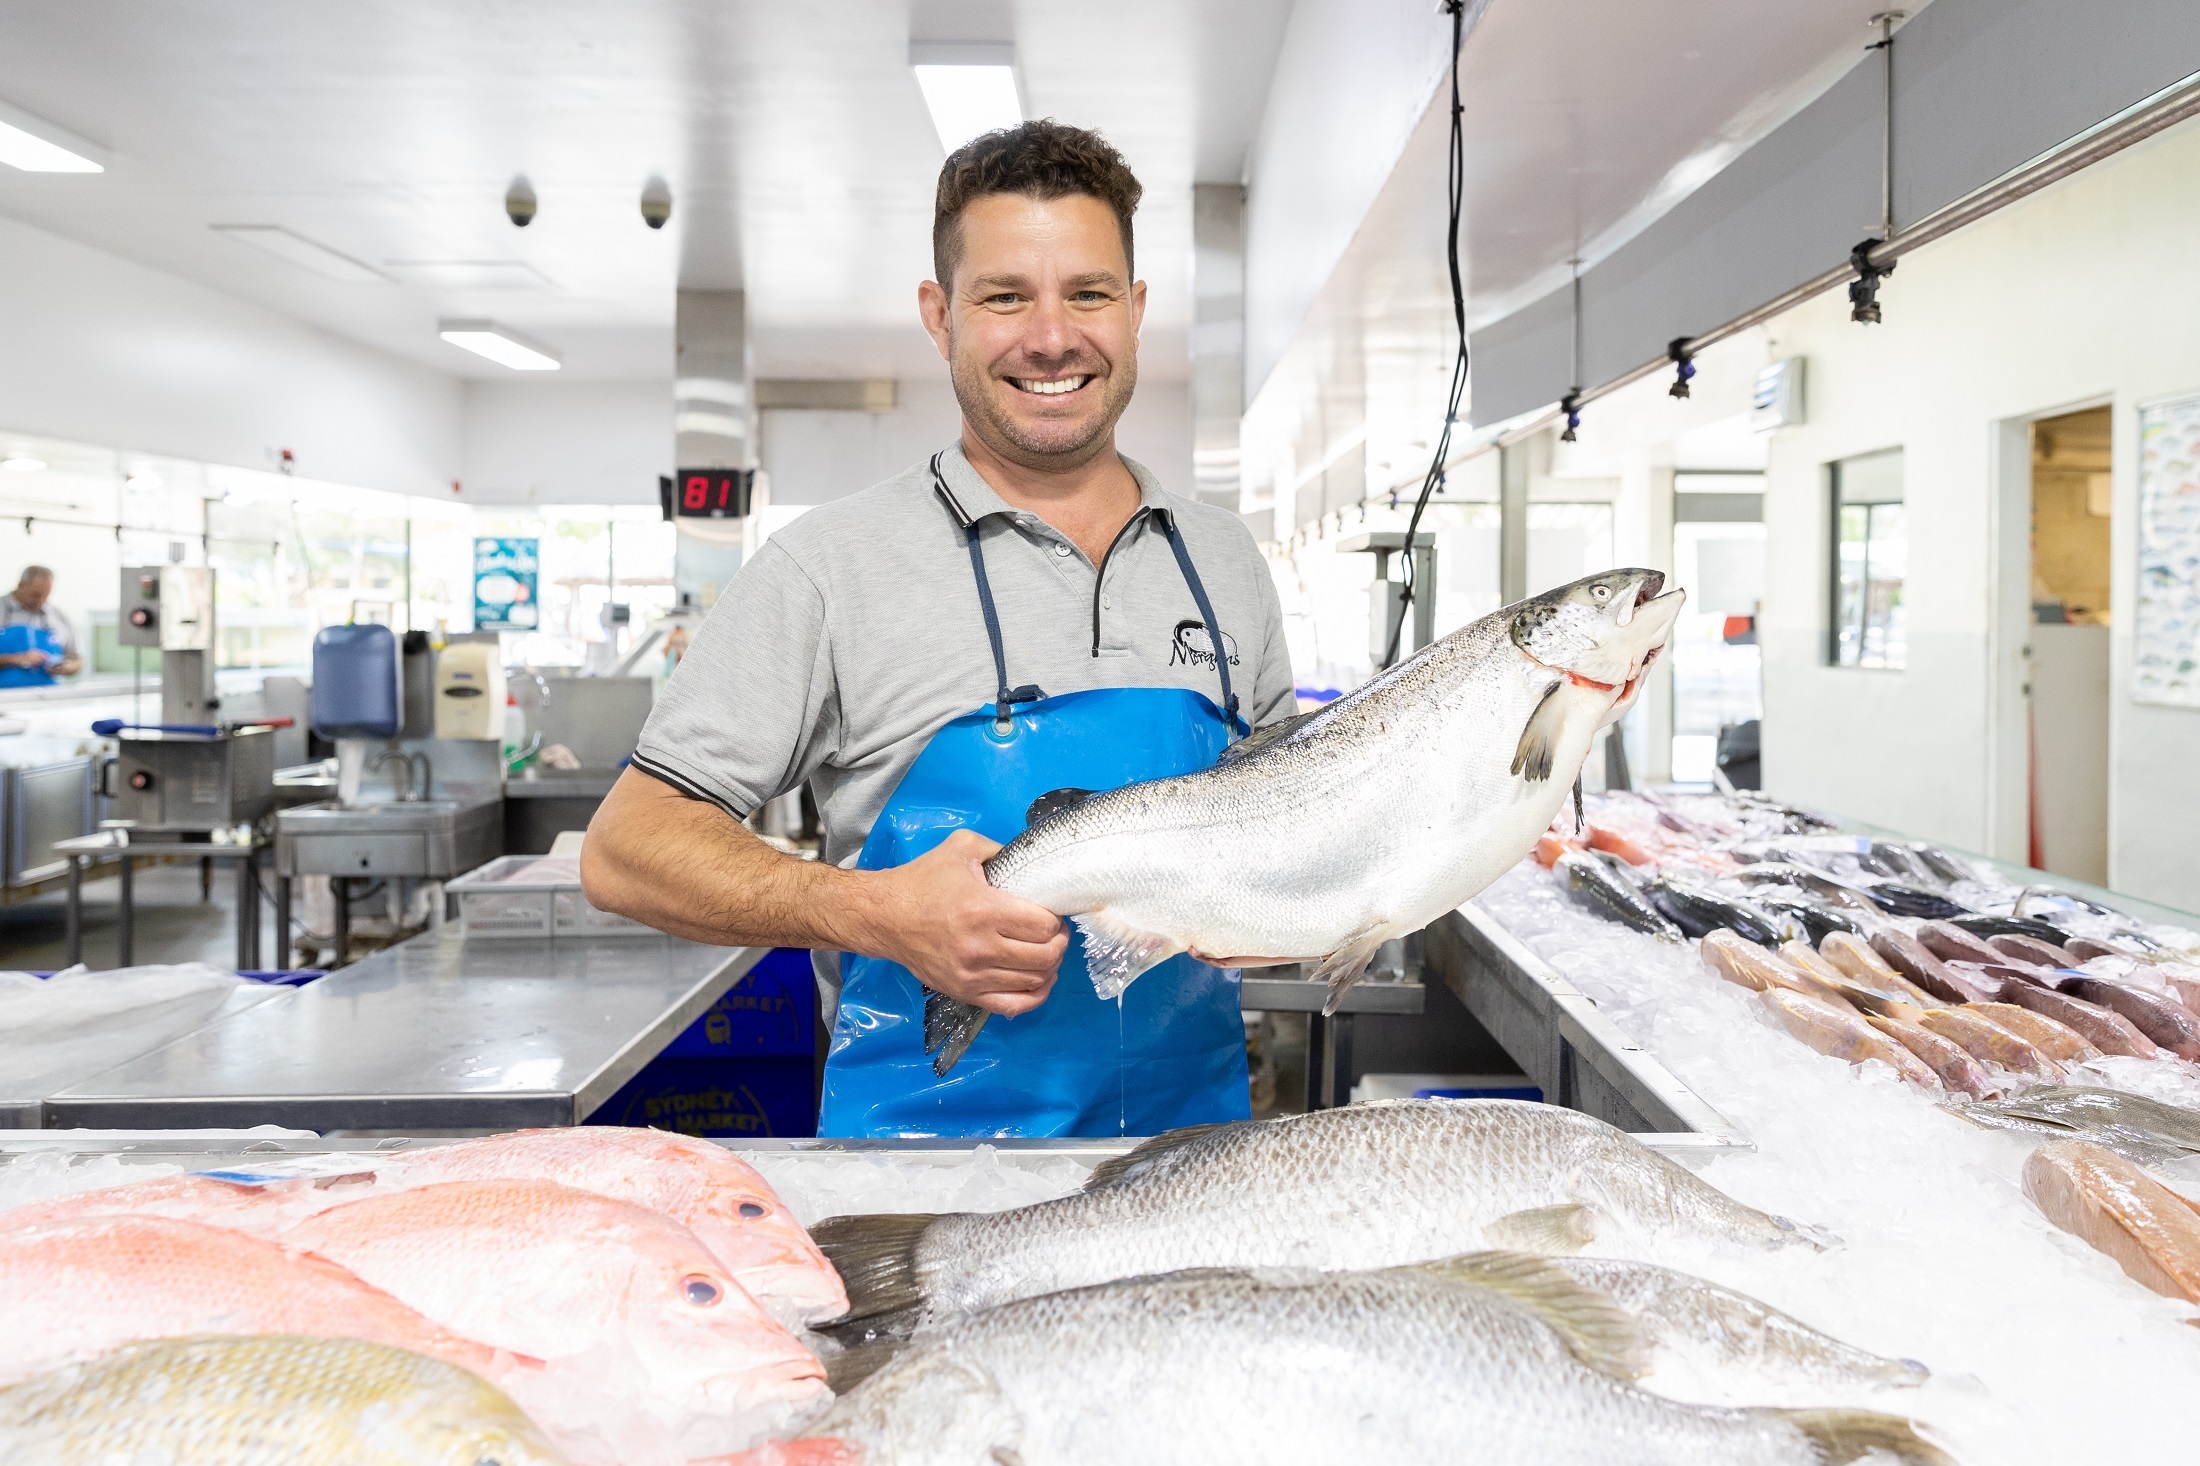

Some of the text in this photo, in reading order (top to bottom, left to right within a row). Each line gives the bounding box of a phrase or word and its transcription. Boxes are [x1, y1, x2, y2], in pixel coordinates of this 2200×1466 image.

[684, 476, 731, 510] 81
[1169, 639, 1240, 671] Morgns
[645, 1091, 735, 1117] SYDNEY
[676, 1112, 760, 1132] MARKET
